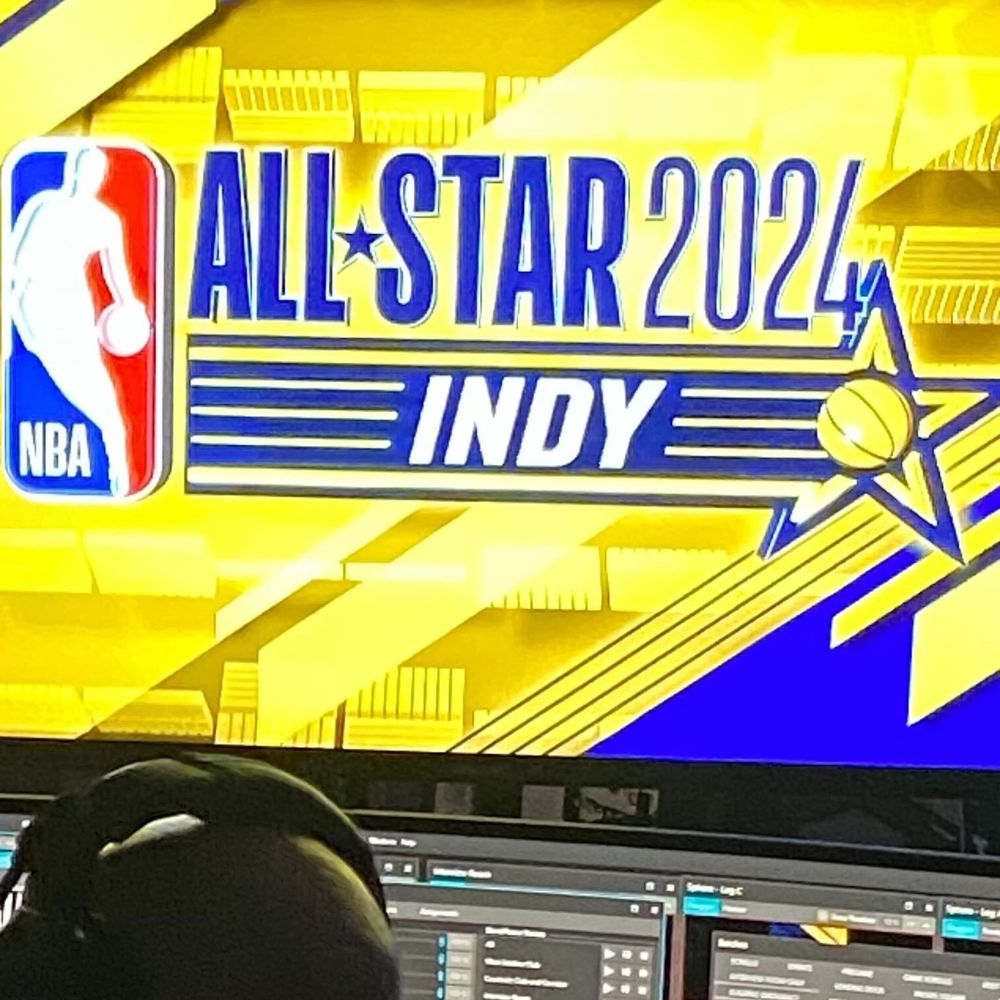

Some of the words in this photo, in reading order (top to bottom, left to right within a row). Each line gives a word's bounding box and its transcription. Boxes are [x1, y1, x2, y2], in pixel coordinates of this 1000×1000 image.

[642, 155, 866, 336] 2024
[18, 420, 92, 478] NBA
[407, 374, 668, 470] INDY
